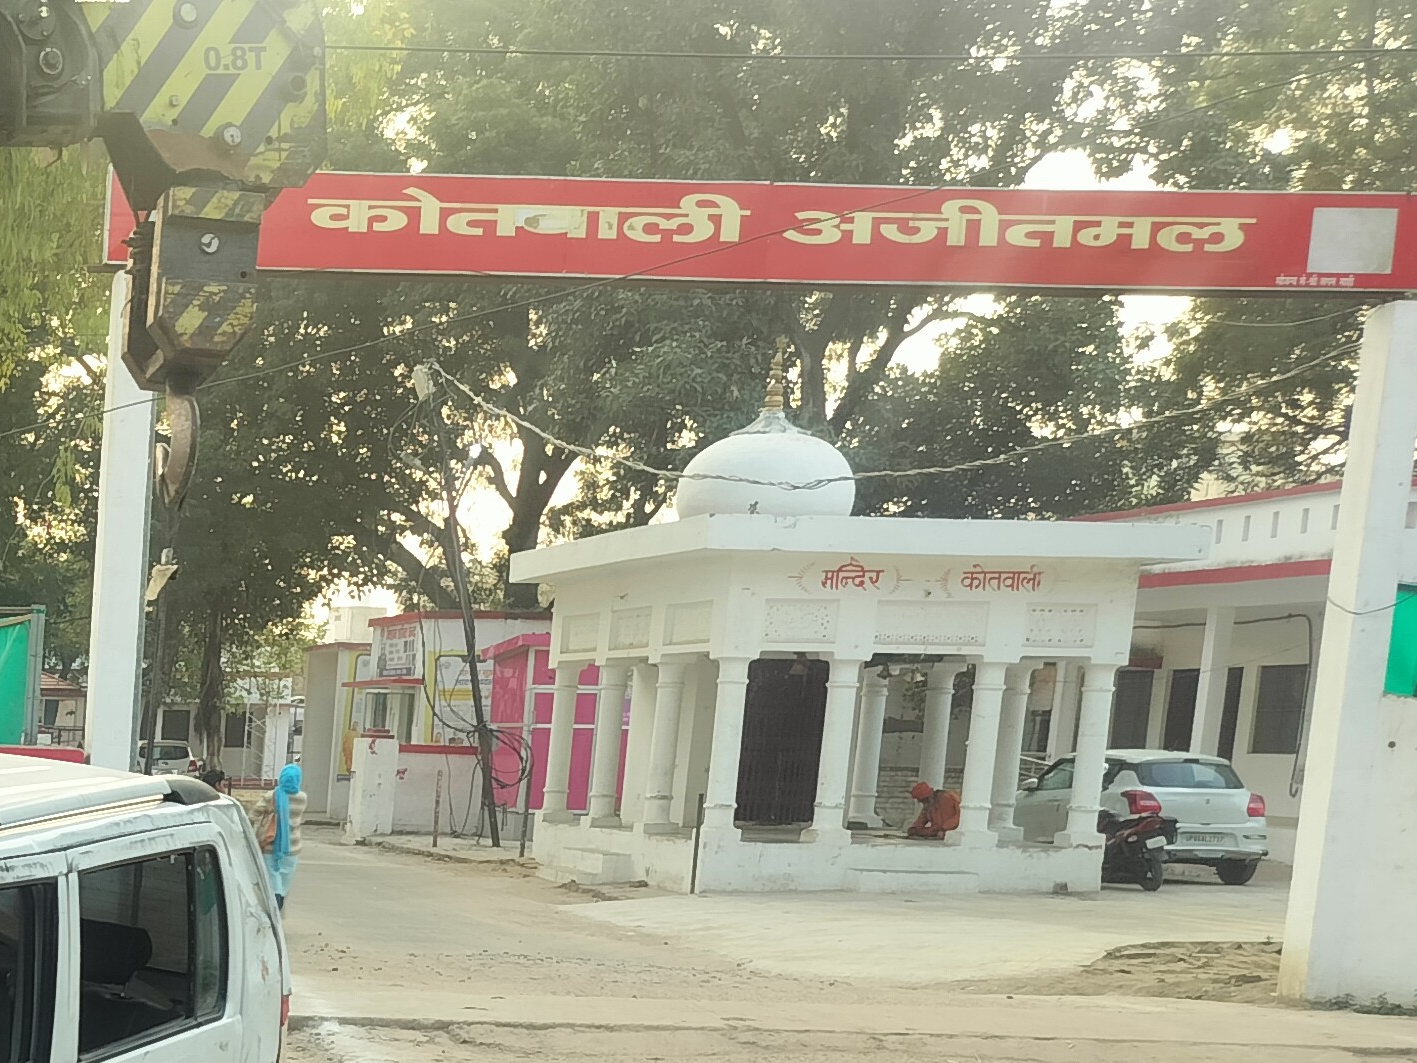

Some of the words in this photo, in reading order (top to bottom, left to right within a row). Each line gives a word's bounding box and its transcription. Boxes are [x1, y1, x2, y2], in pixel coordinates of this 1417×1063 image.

[203, 45, 267, 72] 0.8T
[307, 187, 751, 243] कोतवाली
[783, 199, 1257, 254] अजीतमल
